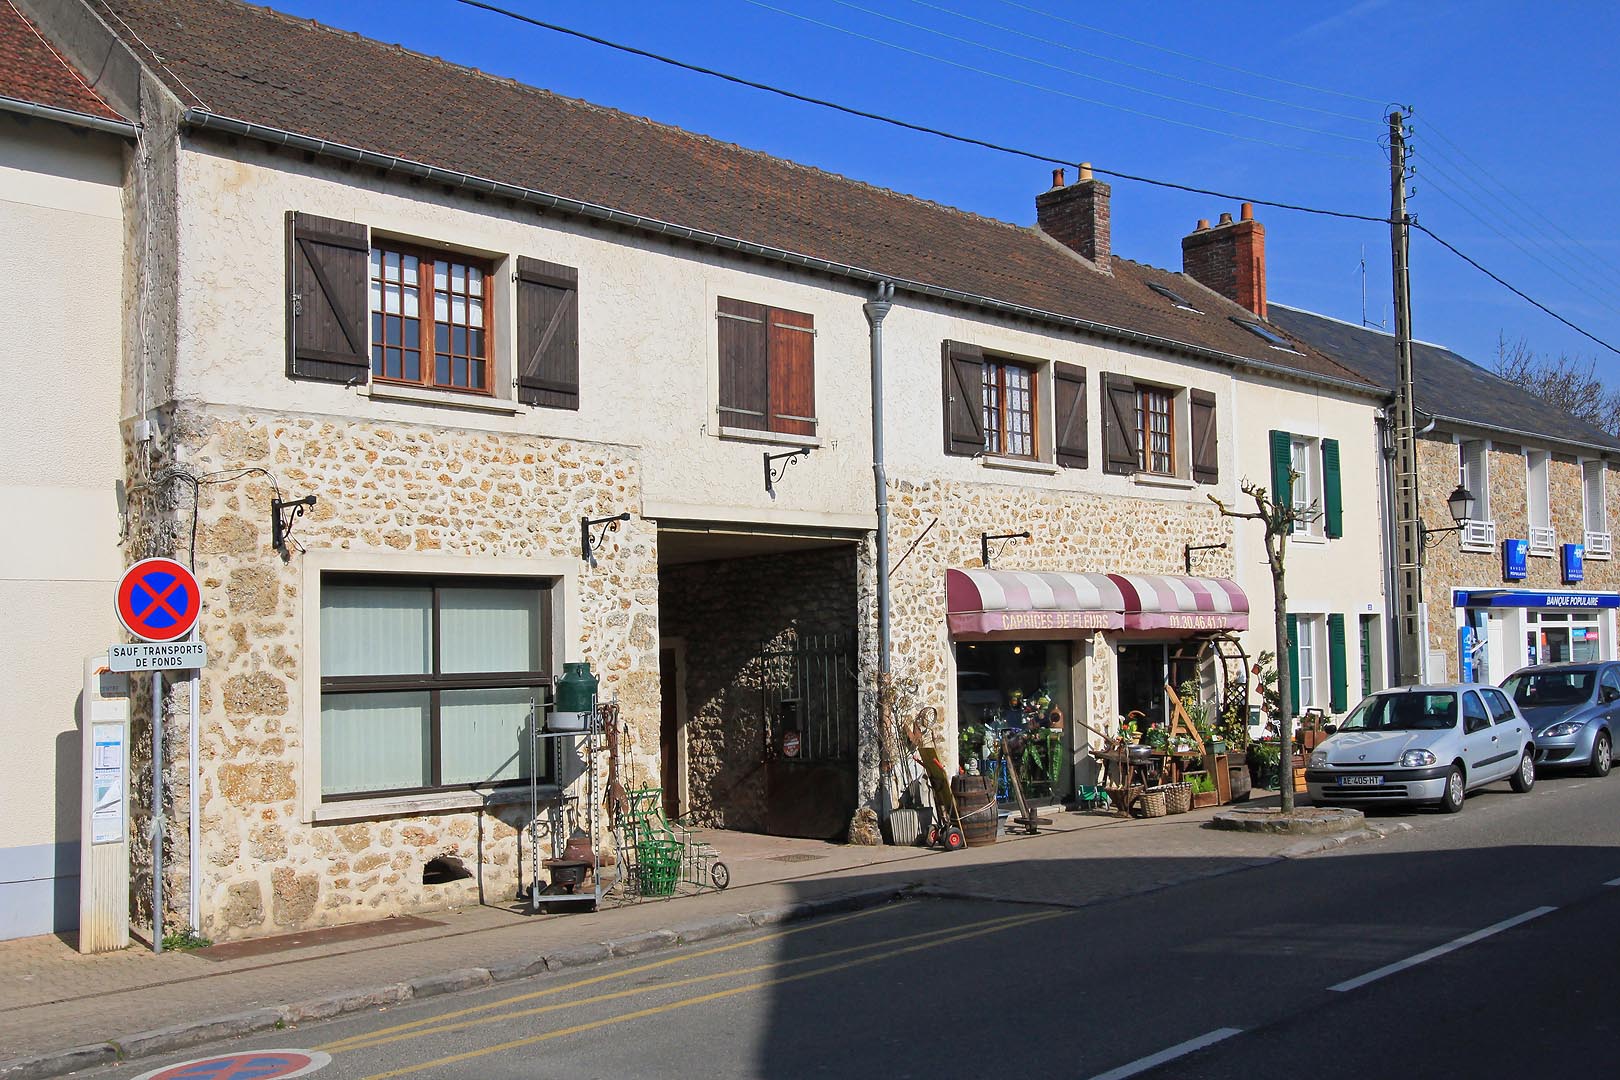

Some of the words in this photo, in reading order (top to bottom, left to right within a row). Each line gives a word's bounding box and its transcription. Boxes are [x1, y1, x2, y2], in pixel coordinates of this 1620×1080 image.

[1546, 596, 1569, 606] BANQUE
[1570, 597, 1599, 606] POPULAIRE
[1002, 614, 1053, 630] CAPRICES
[1056, 614, 1070, 629] DE
[1073, 614, 1109, 629] FLEURS
[113, 647, 139, 657] SAUF
[143, 645, 203, 656] TRANSPORTS
[136, 658, 147, 667] DE
[152, 657, 183, 667] FONDS
